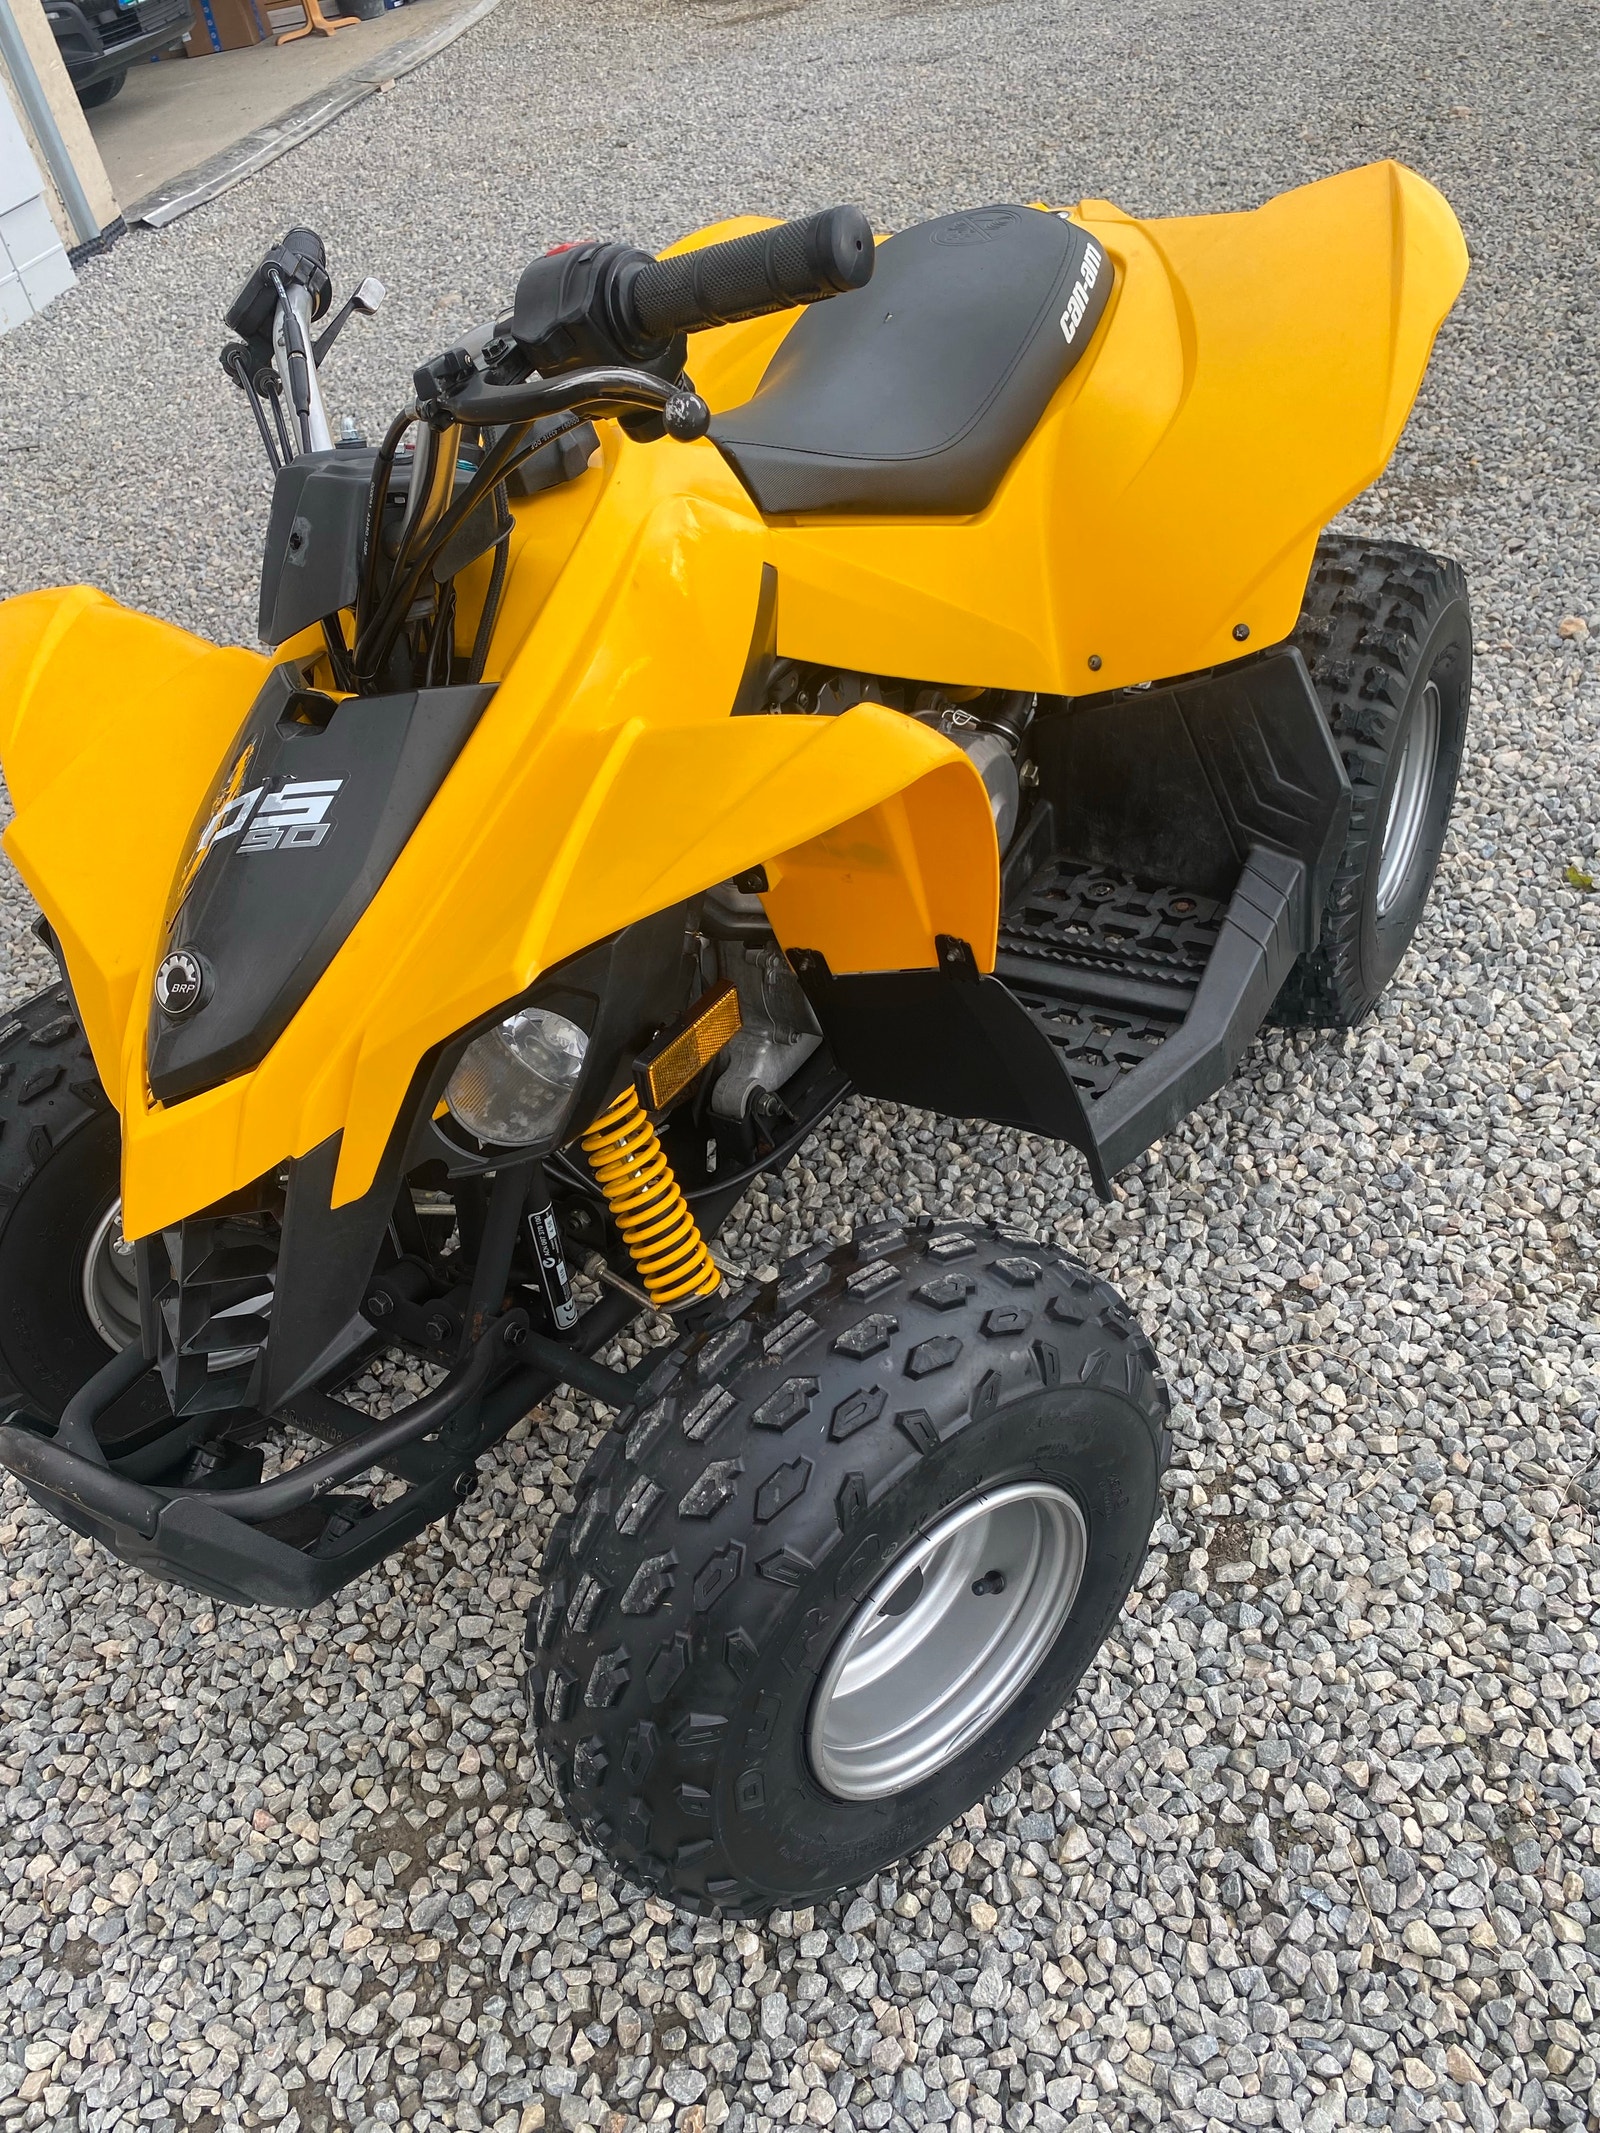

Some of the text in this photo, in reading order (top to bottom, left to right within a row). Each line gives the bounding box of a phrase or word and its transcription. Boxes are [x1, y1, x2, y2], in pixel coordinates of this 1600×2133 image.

[1059, 242, 1101, 344] can-am
[236, 823, 331, 854] 90
[171, 982, 196, 995] BRP
